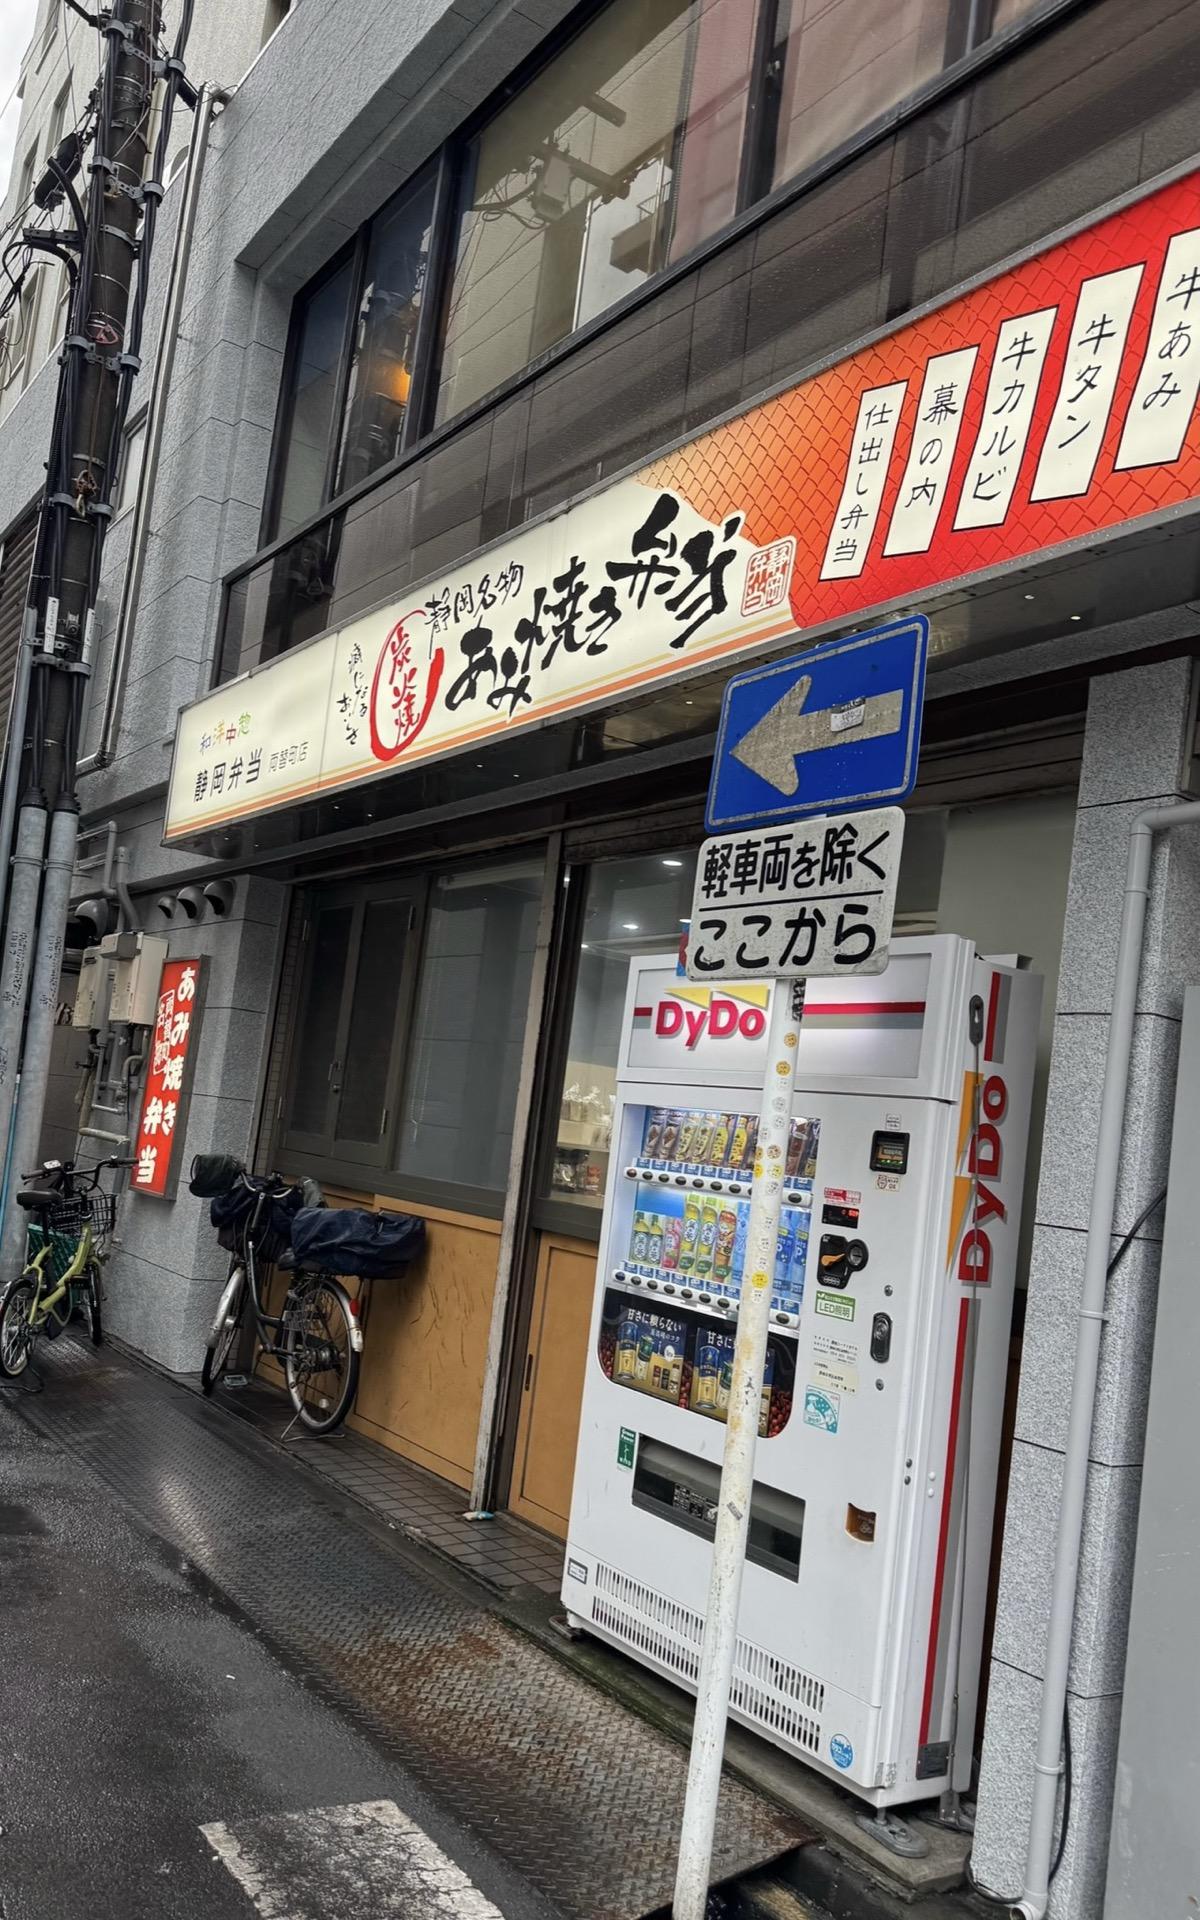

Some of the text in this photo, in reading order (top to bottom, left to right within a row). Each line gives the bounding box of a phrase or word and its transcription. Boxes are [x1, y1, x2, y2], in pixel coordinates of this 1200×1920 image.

[1058, 313, 1117, 449] 牛タン
[1143, 266, 1200, 410] 牛あみ
[905, 382, 959, 507] 幕の内
[972, 331, 1038, 501] 牛カルビ
[832, 402, 893, 563] 仕出し弁当
[424, 560, 523, 659] 静岡名物
[445, 493, 741, 714] あみ焼き弁当
[388, 626, 421, 746] 炭火焼
[194, 747, 262, 802] 静岡弁当
[702, 822, 890, 900] 軽車両を除く
[695, 904, 877, 971] ここから
[656, 1000, 766, 1049] DyDo
[958, 1075, 1007, 1282] DyDo
[707, 1330, 737, 1349] 甘さに
